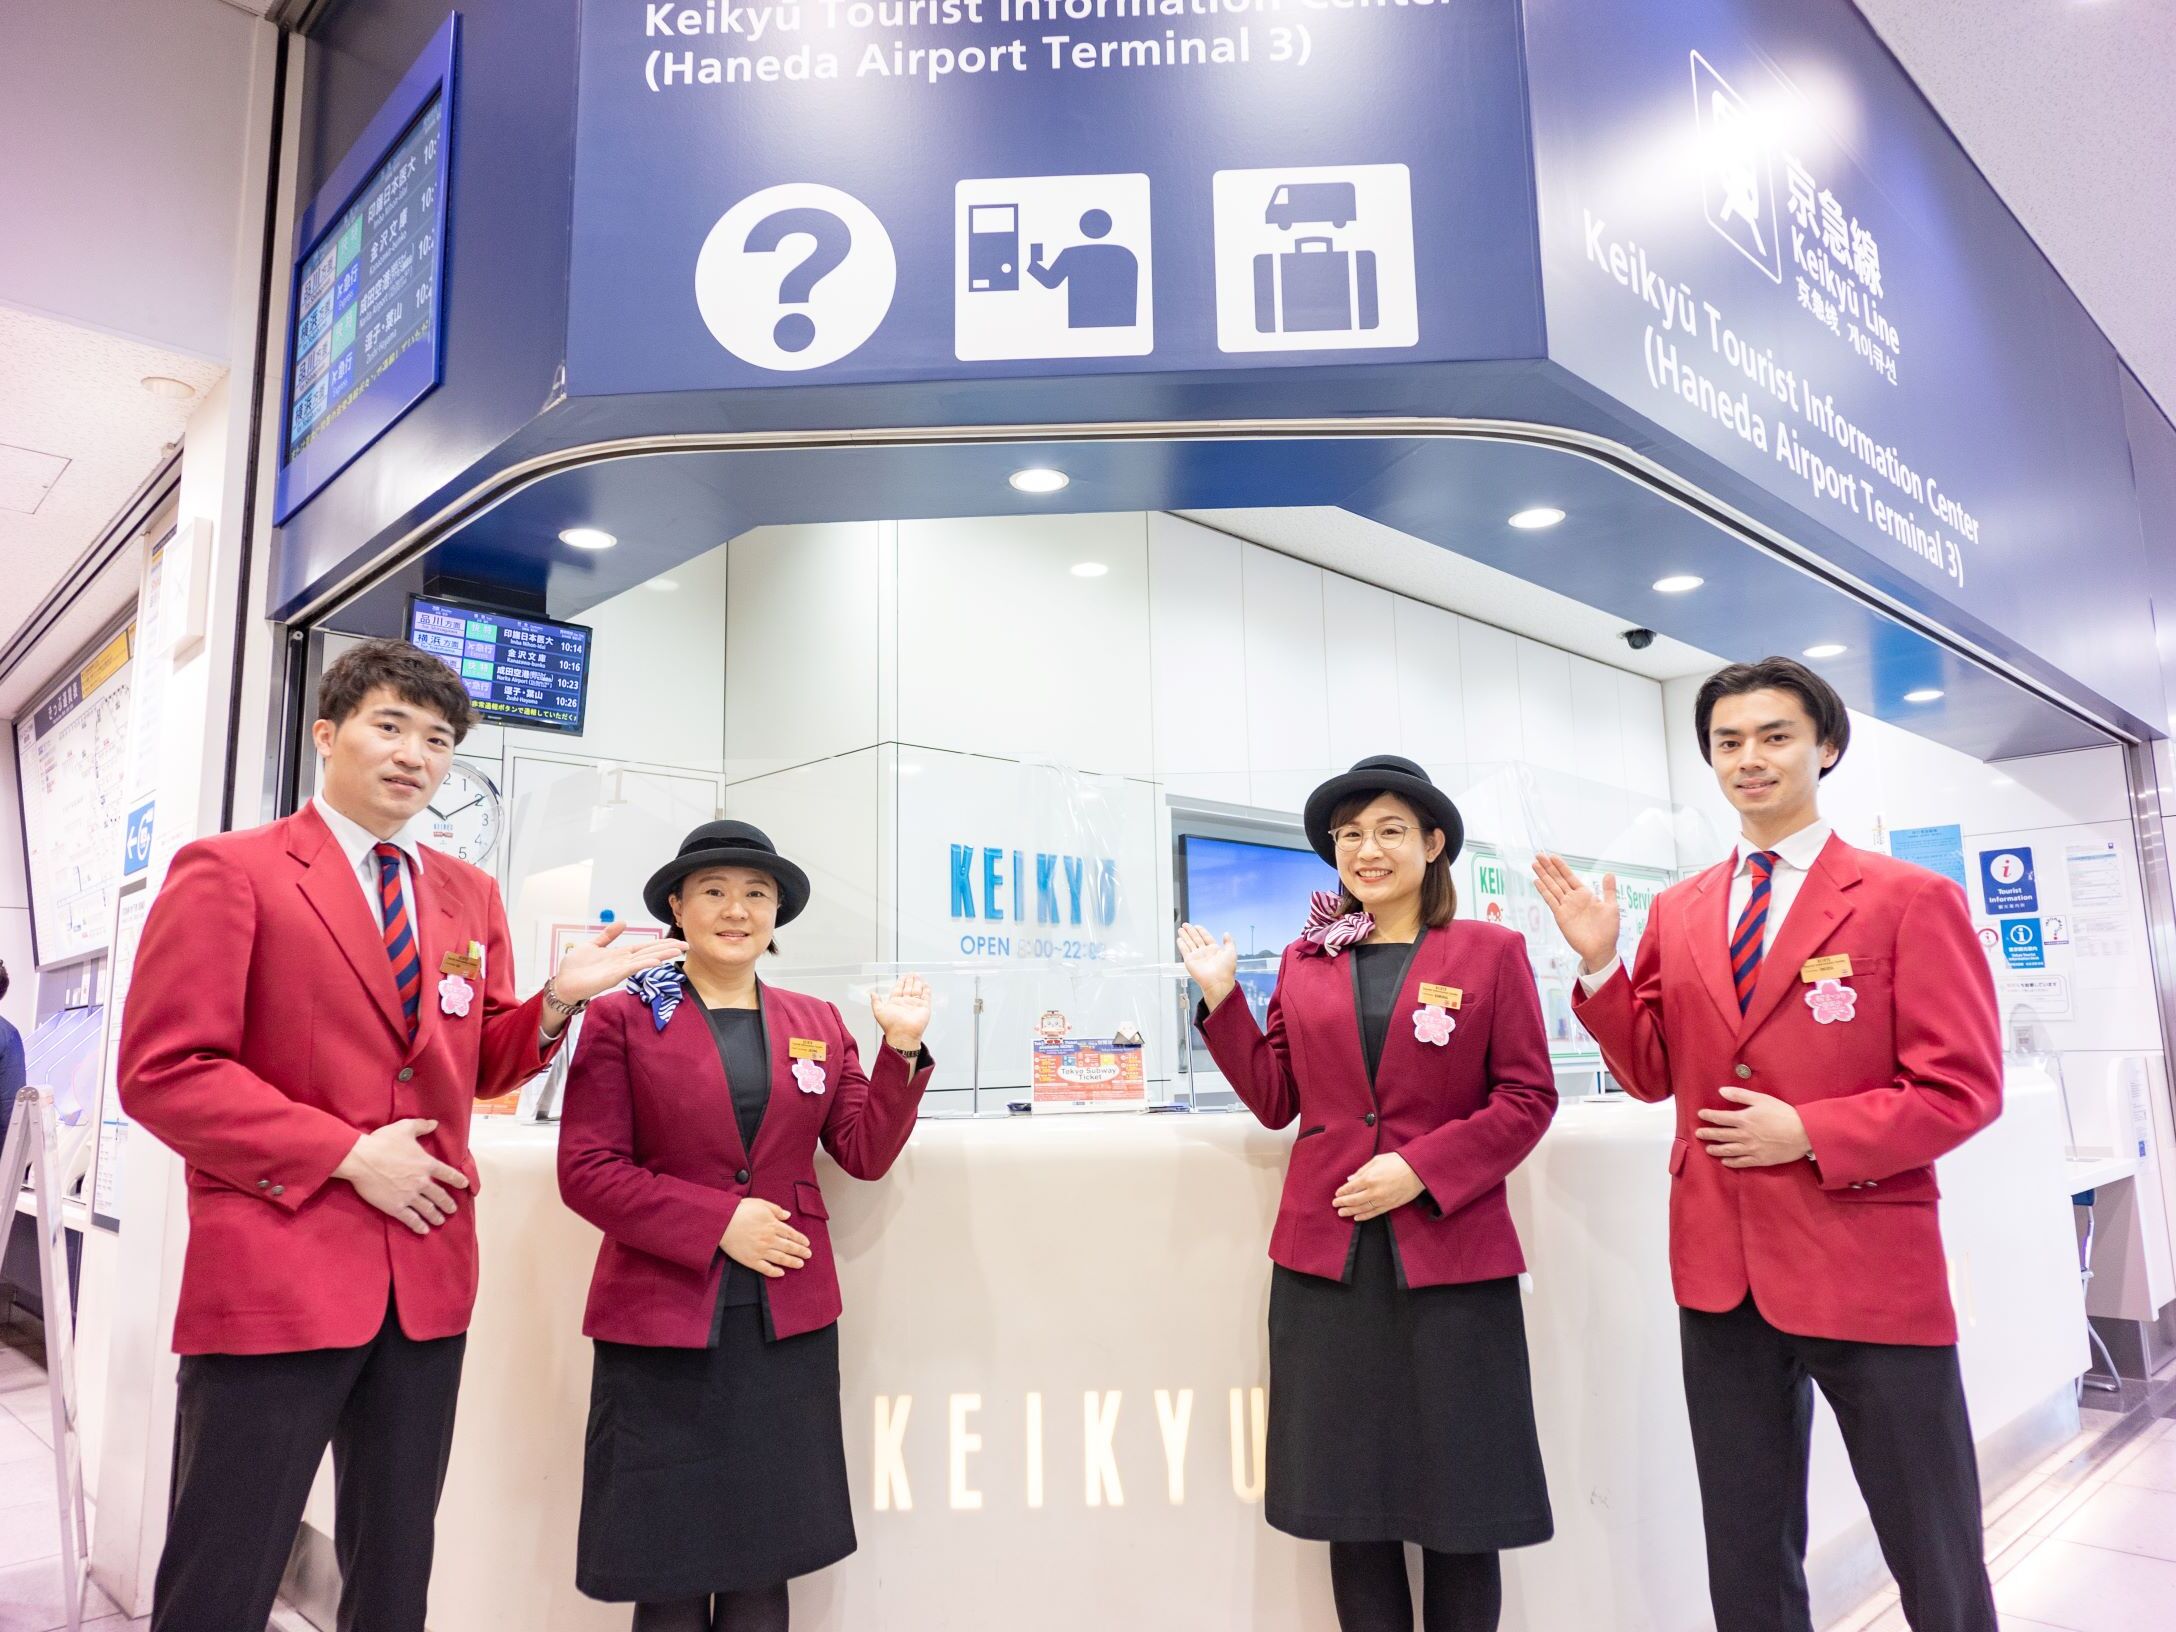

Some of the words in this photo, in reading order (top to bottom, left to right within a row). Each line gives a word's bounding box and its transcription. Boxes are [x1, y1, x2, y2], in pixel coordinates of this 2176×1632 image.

[816, 0, 983, 29] Tourist
[644, 44, 838, 92] (Haneda
[855, 38, 1027, 83] Airport
[1041, 26, 1250, 70] Terminal
[1268, 23, 1312, 66] 3)
[1783, 150, 1883, 298] 京急線
[1791, 225, 1859, 317] Keikyū
[1863, 293, 1900, 354] Line
[1583, 207, 1697, 336] Keikyū
[1703, 301, 1799, 412] Tourist
[1803, 378, 1923, 504] Information
[1926, 478, 1979, 544] Center
[1644, 325, 1768, 452] (Haneda
[1776, 421, 1859, 513] Airport
[1860, 479, 1944, 569] Terminal
[1945, 540, 1964, 588] 3)
[561, 641, 582, 654] 10:14
[507, 648, 547, 663] 金沢文庫
[560, 660, 581, 672] 10:16
[557, 678, 579, 690] 10:23
[555, 696, 577, 708] 10:26
[474, 794, 484, 806] 2
[482, 813, 489, 826] 3
[474, 834, 482, 844] 4
[458, 846, 466, 860] 5
[950, 843, 1116, 926] KEIKYU
[1989, 894, 2032, 903] Information
[960, 935, 1010, 956] OPEN
[874, 1387, 1265, 1510] KEIKYU
